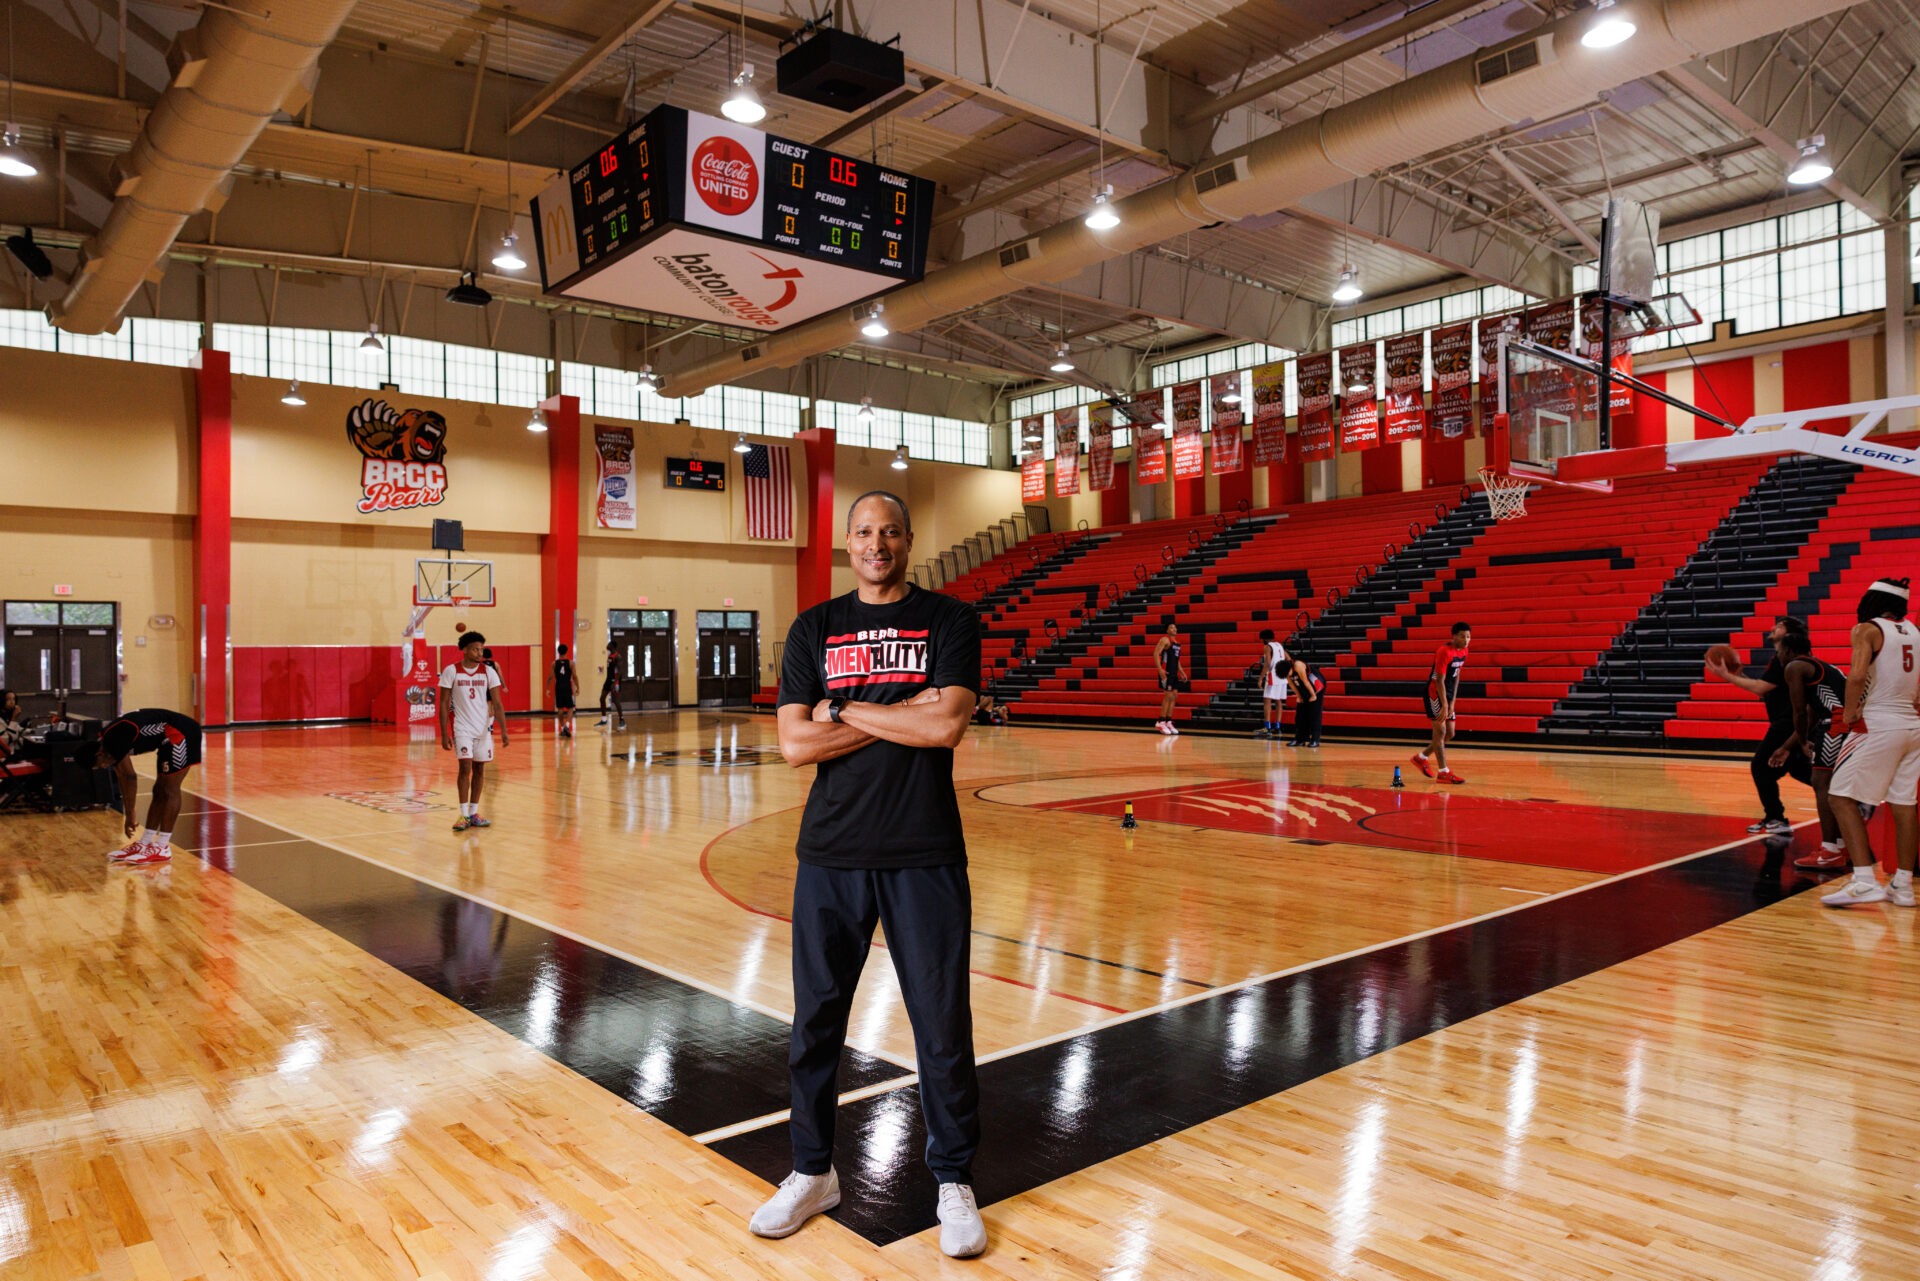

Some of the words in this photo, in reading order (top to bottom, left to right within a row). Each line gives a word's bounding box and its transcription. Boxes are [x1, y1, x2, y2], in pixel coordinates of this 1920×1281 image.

[772, 141, 809, 160] GUEST
[701, 152, 752, 181] Coca-Cola
[830, 157, 857, 188] 0.6
[791, 162, 805, 189] 0
[879, 171, 909, 189] HOME
[700, 177, 749, 200] UNITED
[815, 191, 847, 207] PERIOD
[895, 191, 907, 216] 0
[777, 203, 800, 216] FOULS
[785, 215, 795, 235] 0
[774, 233, 800, 246] POINTS
[831, 226, 841, 246] 0
[851, 231, 861, 250] 0
[882, 229, 903, 241] FOULS
[819, 244, 844, 255] MATCH
[888, 240, 898, 259] 0
[879, 258, 903, 269] POINTS
[652, 255, 704, 295] COMMUNITY
[1433, 341, 1471, 352] BASKETBALL
[1392, 374, 1420, 387] BRCC
[1440, 370, 1470, 384] BRCC
[1304, 394, 1329, 406] BRCC
[1387, 404, 1423, 416] CHAMPIONS
[1343, 418, 1377, 428] CHAMPIONS
[1388, 424, 1422, 435] 2015-2016
[1344, 432, 1376, 444] 2014-2015
[1841, 445, 1916, 464] LEGACY
[606, 460, 631, 470] BRCC
[364, 459, 445, 490] BRCC
[360, 482, 441, 511] Bears
[857, 627, 898, 642] BEAR
[827, 643, 926, 676] MENTALITY
[1902, 645, 1913, 673] 5
[560, 666, 565, 675] 4
[469, 688, 476, 700] 3
[410, 704, 436, 714] BRCC
